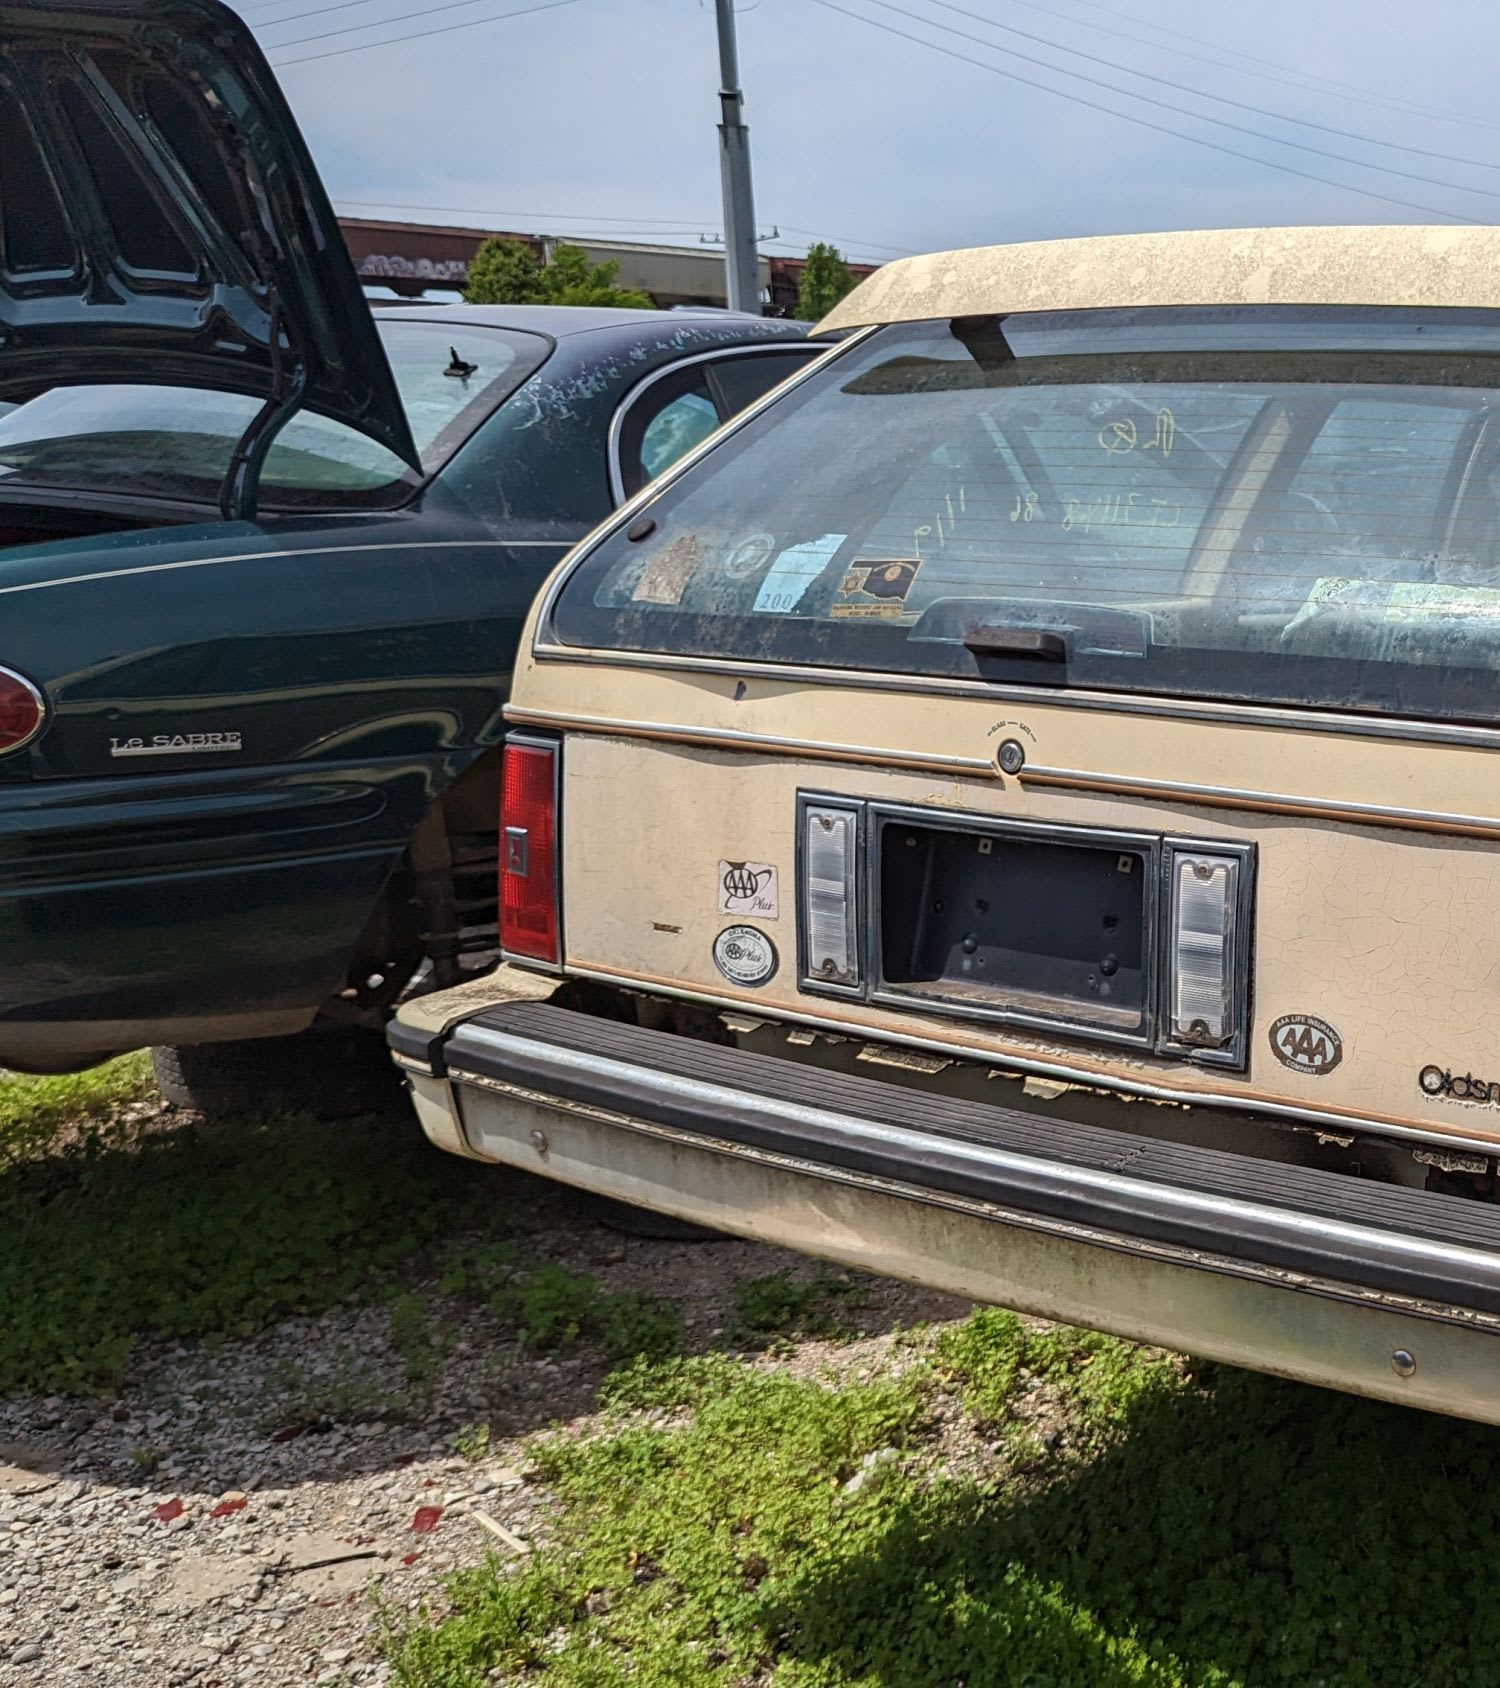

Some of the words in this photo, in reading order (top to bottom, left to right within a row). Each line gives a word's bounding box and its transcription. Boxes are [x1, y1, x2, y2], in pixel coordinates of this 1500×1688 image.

[110, 737, 145, 750] Le
[152, 732, 243, 748] SABRE
[724, 868, 758, 899] AAA
[750, 896, 775, 911] Plus
[739, 948, 762, 963] Plus
[1276, 1016, 1290, 1028] AAA
[1291, 1015, 1306, 1023] LIFE
[1307, 1017, 1341, 1047] INSURANCE
[1281, 1027, 1328, 1065] AAA
[1286, 1059, 1316, 1074] COMPANY
